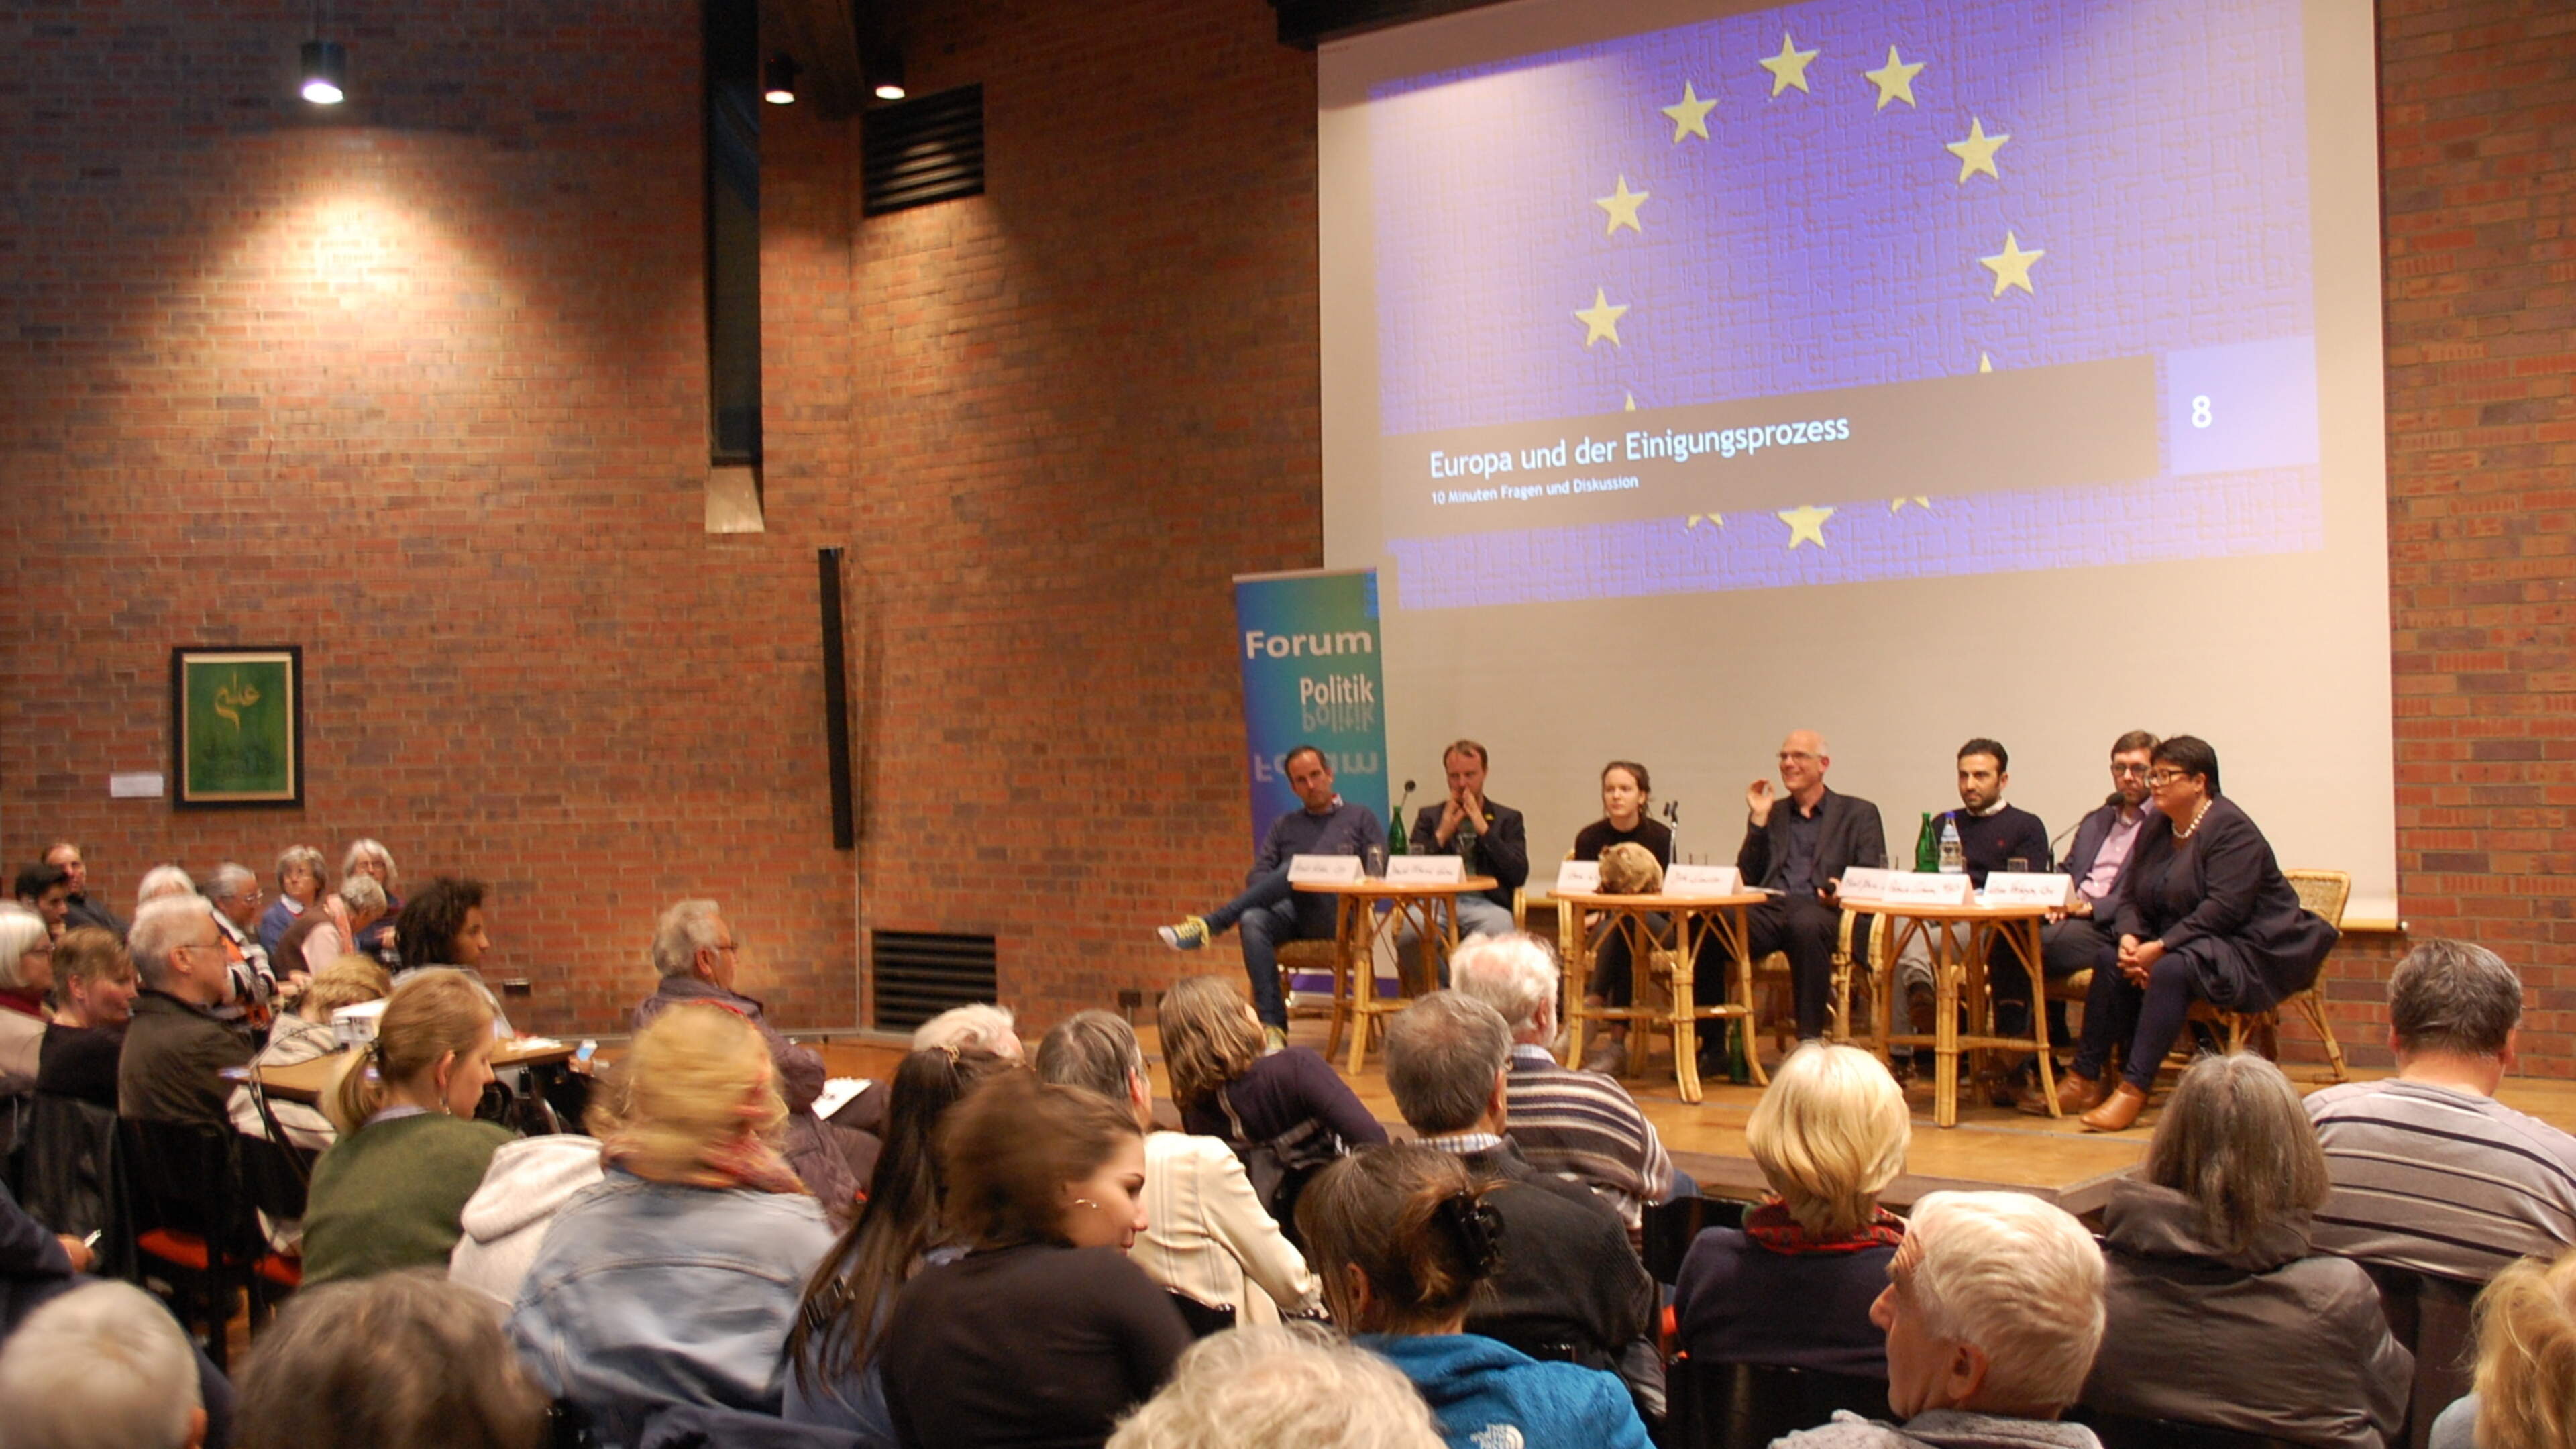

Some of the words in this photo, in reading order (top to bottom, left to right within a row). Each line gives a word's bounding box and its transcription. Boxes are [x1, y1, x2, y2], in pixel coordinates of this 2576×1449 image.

[2192, 395, 2212, 428] 8
[1430, 451, 1513, 479] Europa
[1521, 438, 1567, 470] und
[1574, 436, 1617, 464] der
[1625, 417, 1849, 462] Einigungsprozess
[1432, 492, 1446, 505] 10
[1448, 489, 1497, 504] Minuten
[1501, 483, 1543, 500] Fragen
[1546, 481, 1570, 496] und
[1573, 476, 1639, 494] Diskussion
[1246, 630, 1372, 659] Forum
[1300, 674, 1375, 706] Politik
